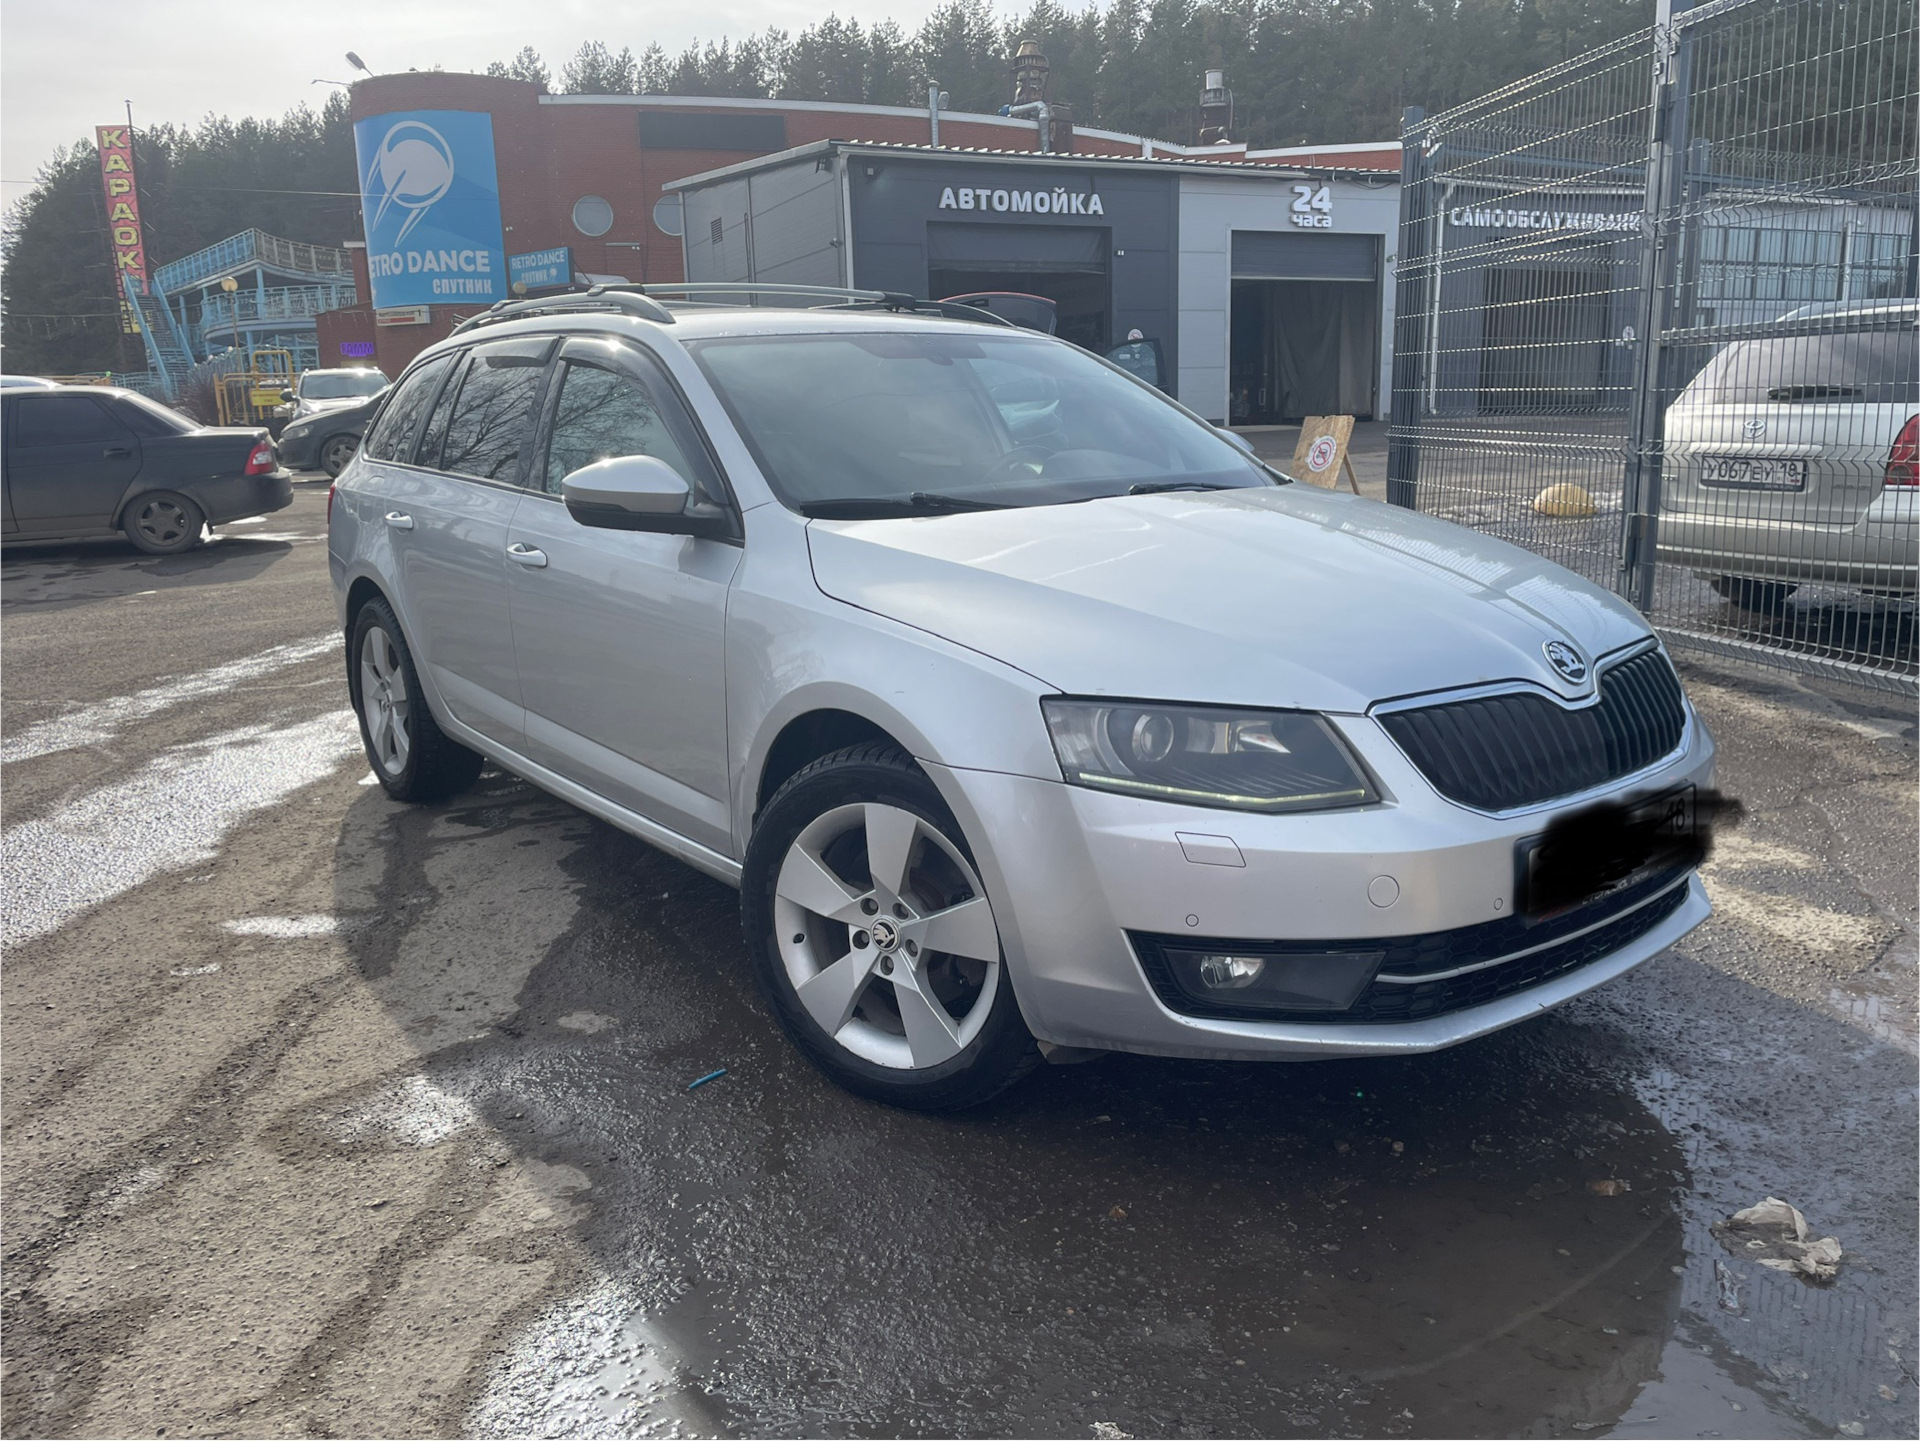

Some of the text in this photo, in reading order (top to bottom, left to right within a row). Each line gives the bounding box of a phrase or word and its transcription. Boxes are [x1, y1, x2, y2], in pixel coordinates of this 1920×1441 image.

[938, 186, 1105, 215] АВТОМОЙКА
[1292, 185, 1333, 213] 24
[1291, 212, 1333, 228] часа
[1450, 207, 1641, 232] САМООБСЛУЖИВАНИ
[406, 249, 491, 274] DANCE
[511, 250, 565, 270] RETRO DANCE
[432, 278, 493, 295] СПУТНИК
